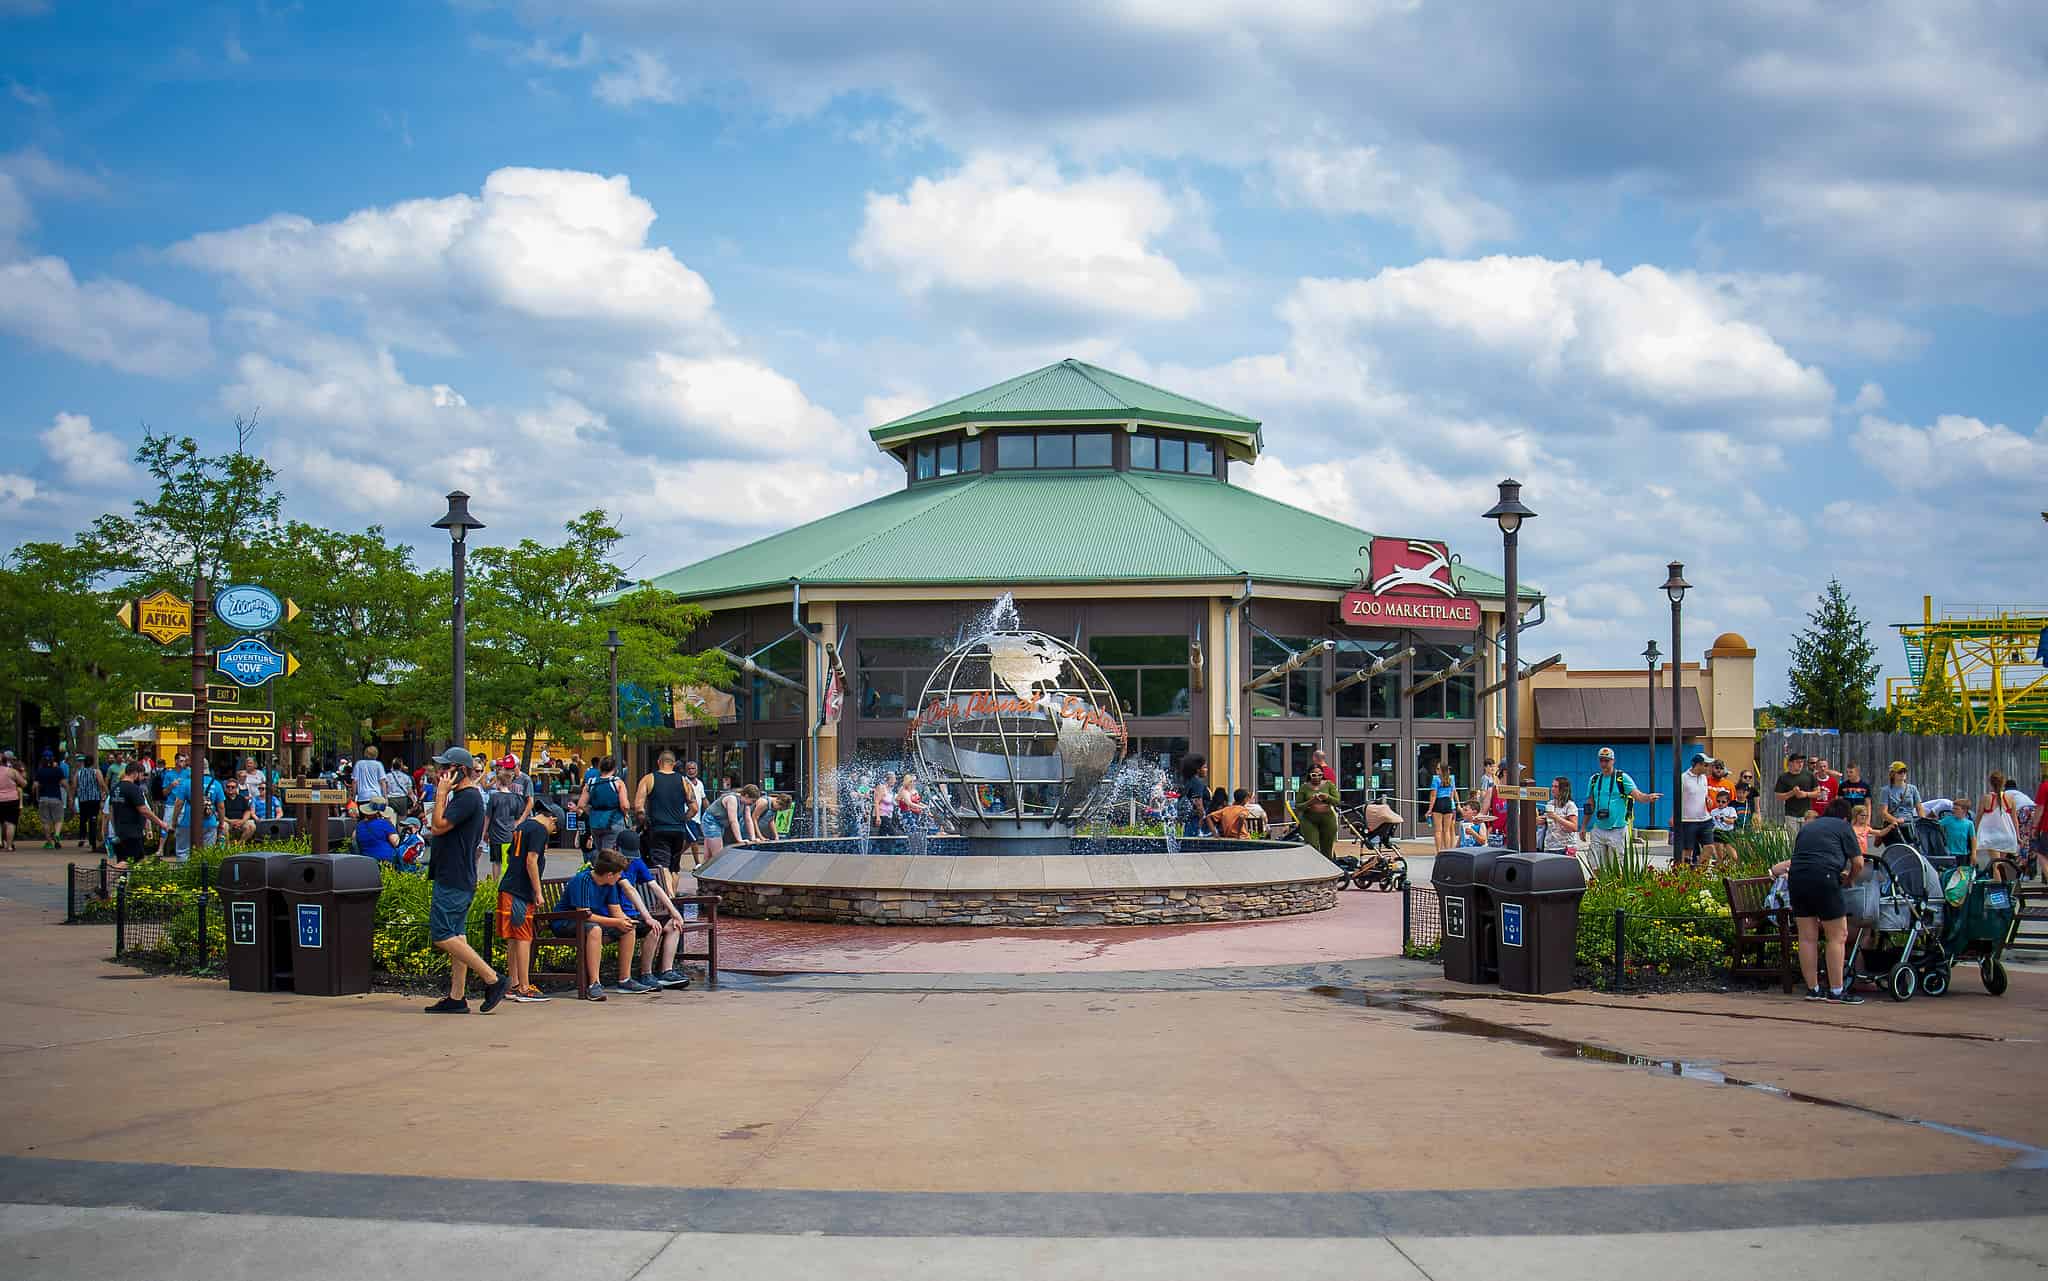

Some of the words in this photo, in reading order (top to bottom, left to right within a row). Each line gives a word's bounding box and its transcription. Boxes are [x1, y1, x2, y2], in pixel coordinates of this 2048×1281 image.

[1353, 600, 1381, 616] ZOO
[1385, 602, 1473, 621] MARKETPLACE
[145, 613, 187, 628] AFRICA
[224, 653, 275, 665] ADVENTURE
[236, 663, 263, 673] COVE
[965, 689, 1042, 720] Planet
[222, 735, 248, 747] Stingray
